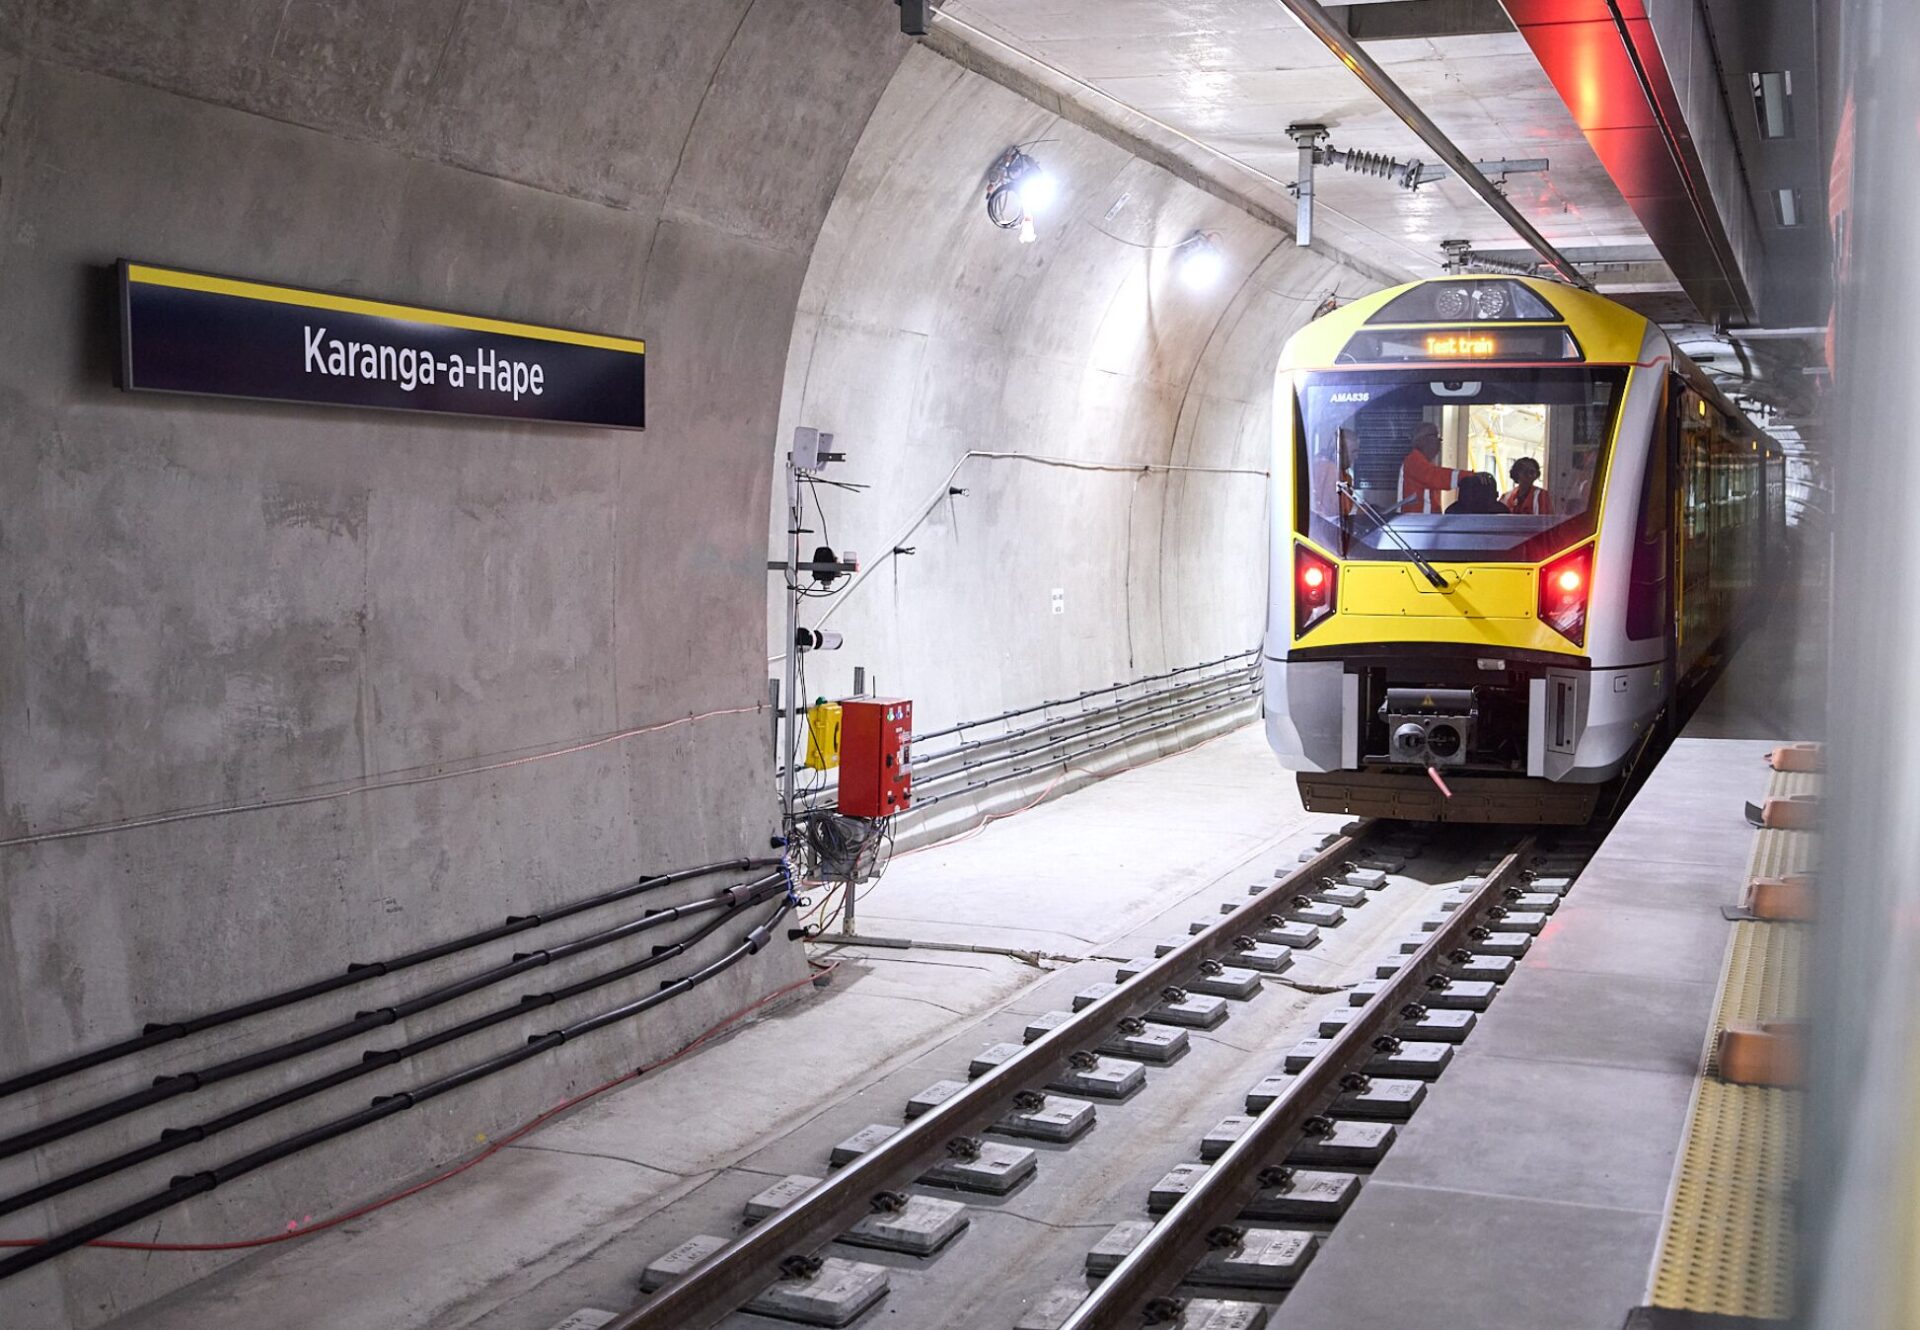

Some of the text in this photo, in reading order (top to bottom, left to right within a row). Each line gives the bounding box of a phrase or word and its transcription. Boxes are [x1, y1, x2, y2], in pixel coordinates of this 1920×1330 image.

[303, 325, 545, 401] Karanga-a-Hape
[1426, 337, 1494, 354] Test train
